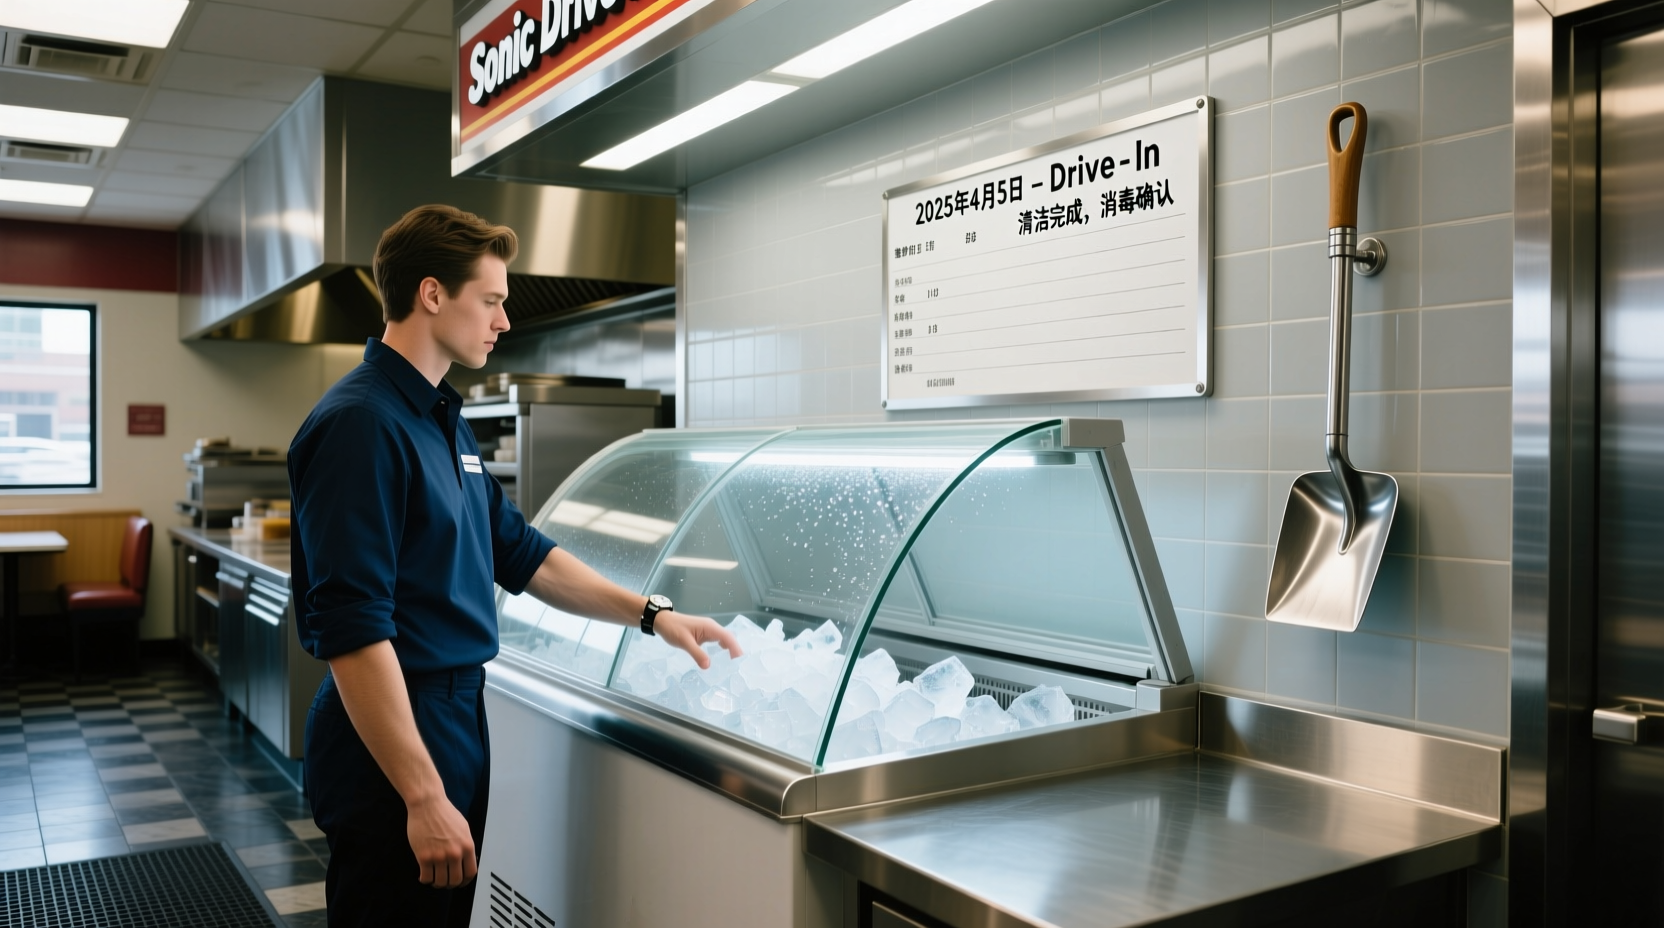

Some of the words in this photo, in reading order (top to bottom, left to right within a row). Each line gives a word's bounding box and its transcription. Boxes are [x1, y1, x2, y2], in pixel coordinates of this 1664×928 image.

[468, 10, 535, 104] Sonic
[915, 175, 1023, 225] 2025年4月5日
